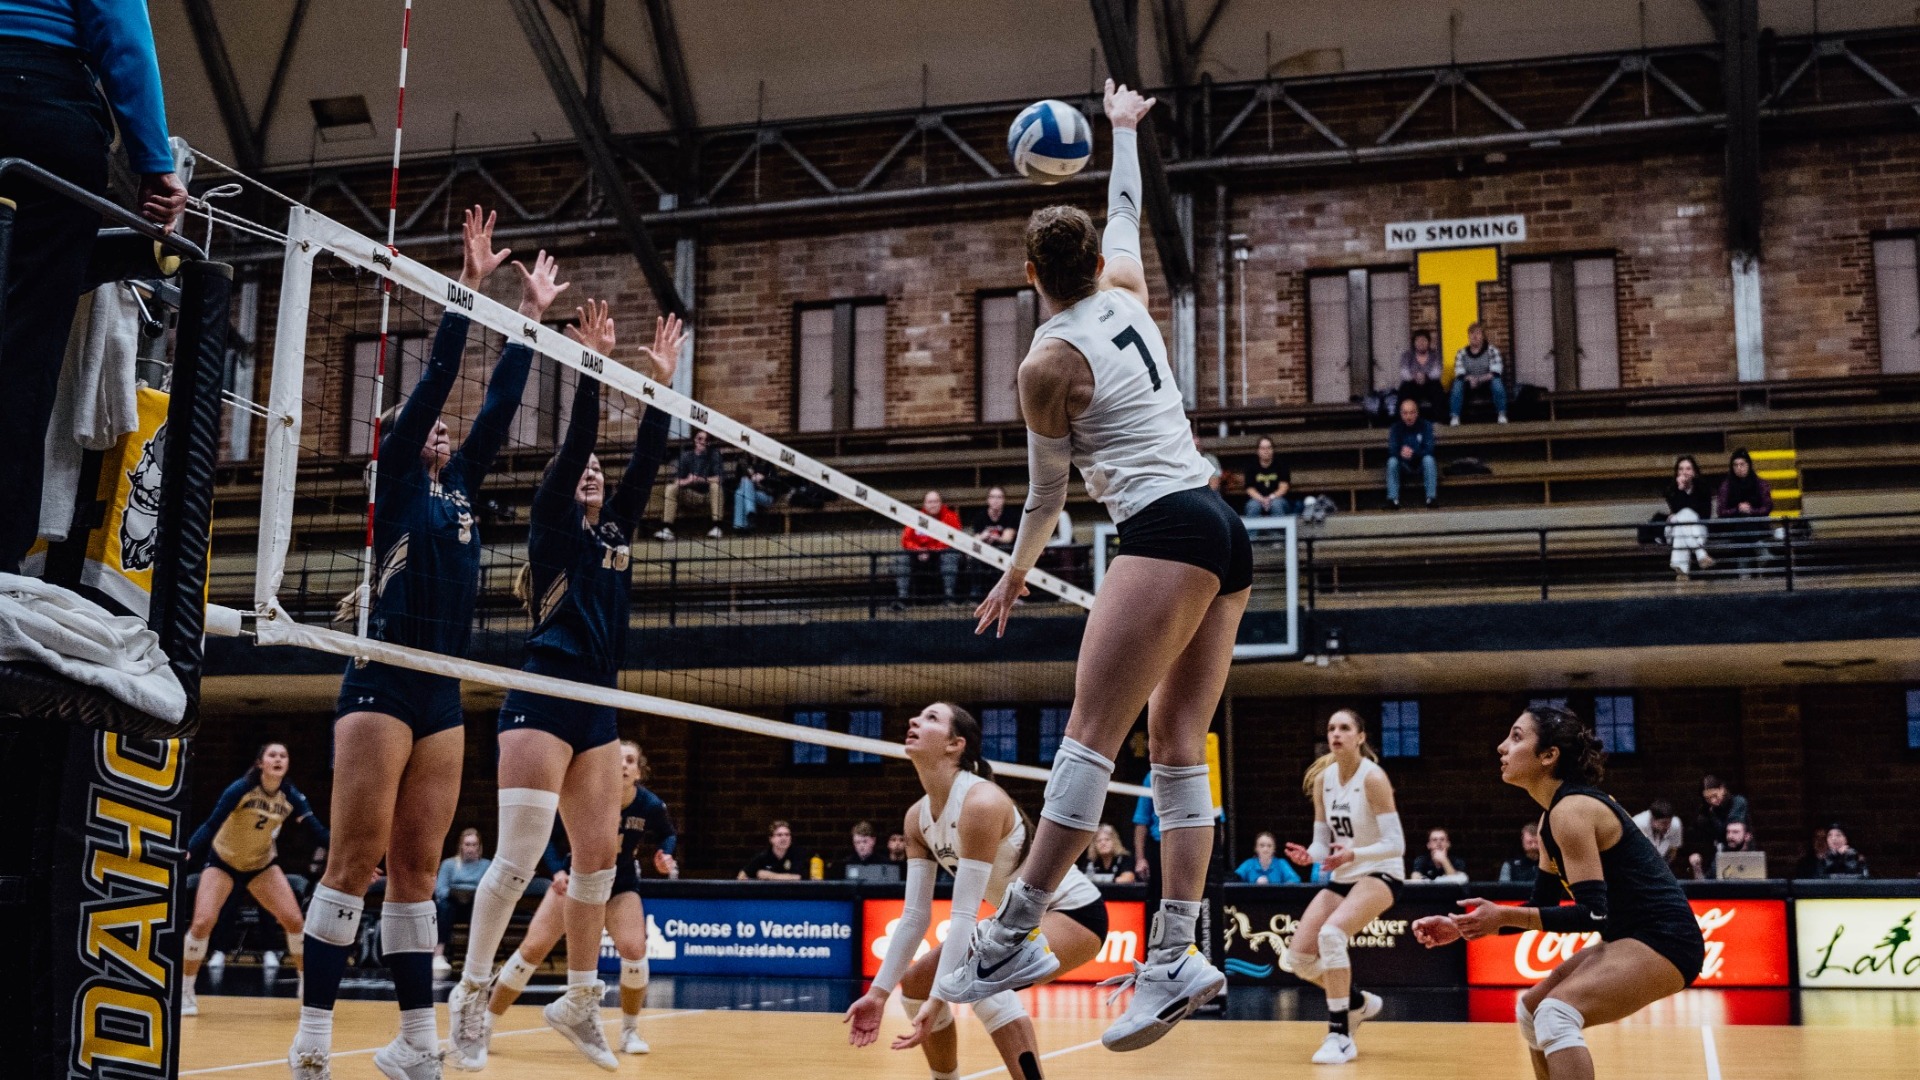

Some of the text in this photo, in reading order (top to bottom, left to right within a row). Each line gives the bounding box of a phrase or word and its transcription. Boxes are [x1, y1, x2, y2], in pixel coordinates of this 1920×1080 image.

[1391, 221, 1519, 243] NO SMOKING
[447, 282, 475, 311] IDAHO
[580, 350, 604, 374] IDAHO
[1111, 324, 1162, 393] 7
[689, 403, 709, 425] IDAHO
[602, 541, 630, 571] 10
[255, 814, 269, 829] 2
[1330, 815, 1354, 838] 20
[70, 731, 187, 1080] DAHO
[665, 919, 852, 940] Choose to Vaccinate
[684, 942, 831, 958] immunizeidaho.com
[1349, 935, 1397, 949] LODGE
